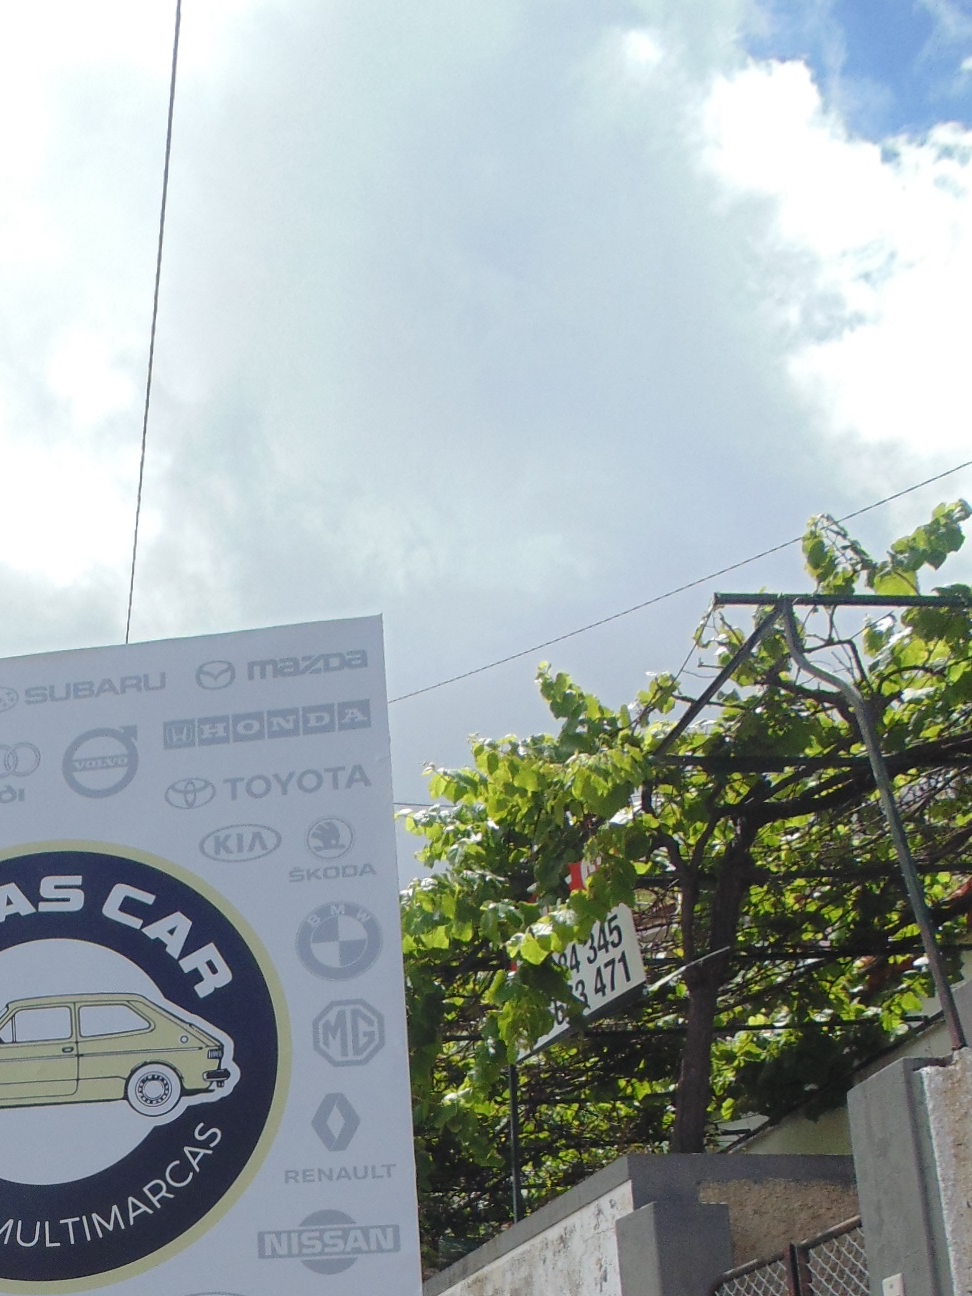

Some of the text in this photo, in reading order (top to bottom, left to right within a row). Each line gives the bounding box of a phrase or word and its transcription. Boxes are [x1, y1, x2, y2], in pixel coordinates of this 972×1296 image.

[24, 672, 167, 705] SUBARU
[199, 705, 369, 740] HONDA
[72, 754, 129, 772] VOLVO
[223, 764, 372, 801] TOYOTA
[212, 831, 266, 856] KIA
[307, 904, 372, 928] BMW
[101, 883, 234, 999] CAR
[586, 914, 623, 965] 345
[594, 950, 632, 998] 471
[321, 1007, 376, 1058] MG
[284, 1164, 397, 1184] RENAULT
[263, 1226, 396, 1256] NISSAN
